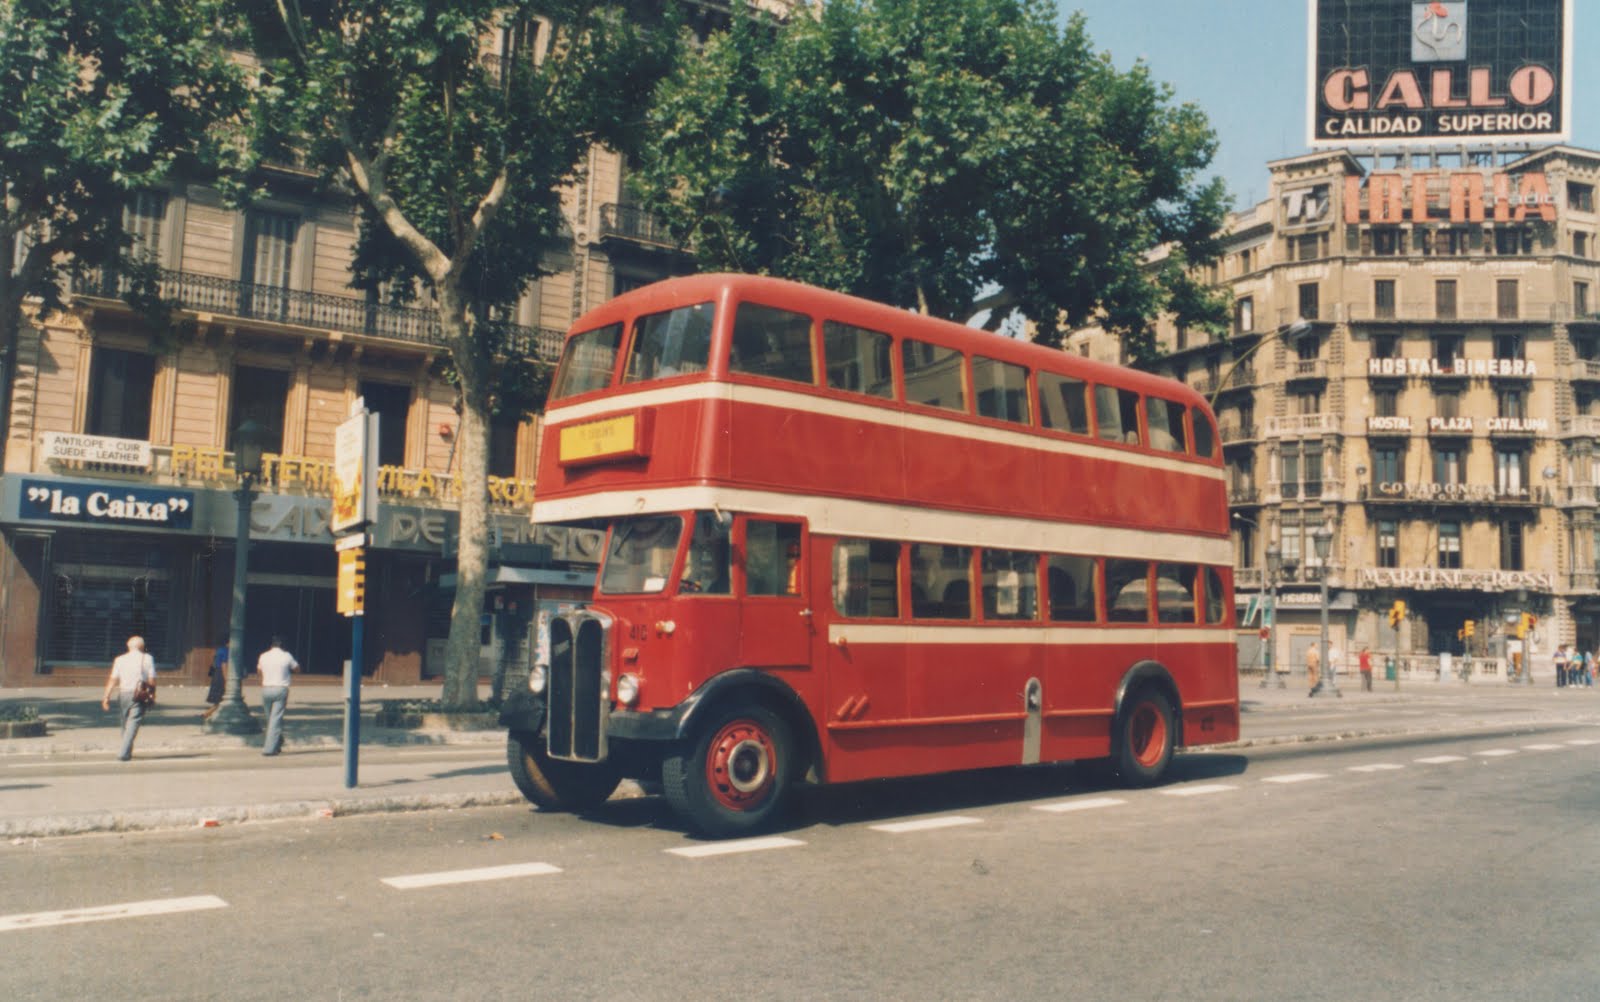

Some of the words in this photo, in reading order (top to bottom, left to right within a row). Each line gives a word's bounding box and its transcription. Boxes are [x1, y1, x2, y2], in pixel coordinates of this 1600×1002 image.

[1323, 64, 1555, 111] GALLO
[1325, 116, 1422, 135] CALIDAD
[1438, 112, 1552, 133] SUPERIOR
[1344, 171, 1557, 223] IBERIA
[1368, 357, 1444, 375] HOSTAL
[1368, 416, 1413, 430] HOSTAL
[1430, 417, 1473, 430] PLAZA
[53, 435, 105, 450] ANTILOPE
[116, 440, 141, 452] CUIR
[53, 446, 87, 458] SUEDE
[96, 450, 140, 462] LEATHER
[250, 501, 331, 538] CAIX
[391, 513, 446, 546] DE
[1364, 568, 1460, 586] MARTINI
[1491, 571, 1555, 587] ROSSI
